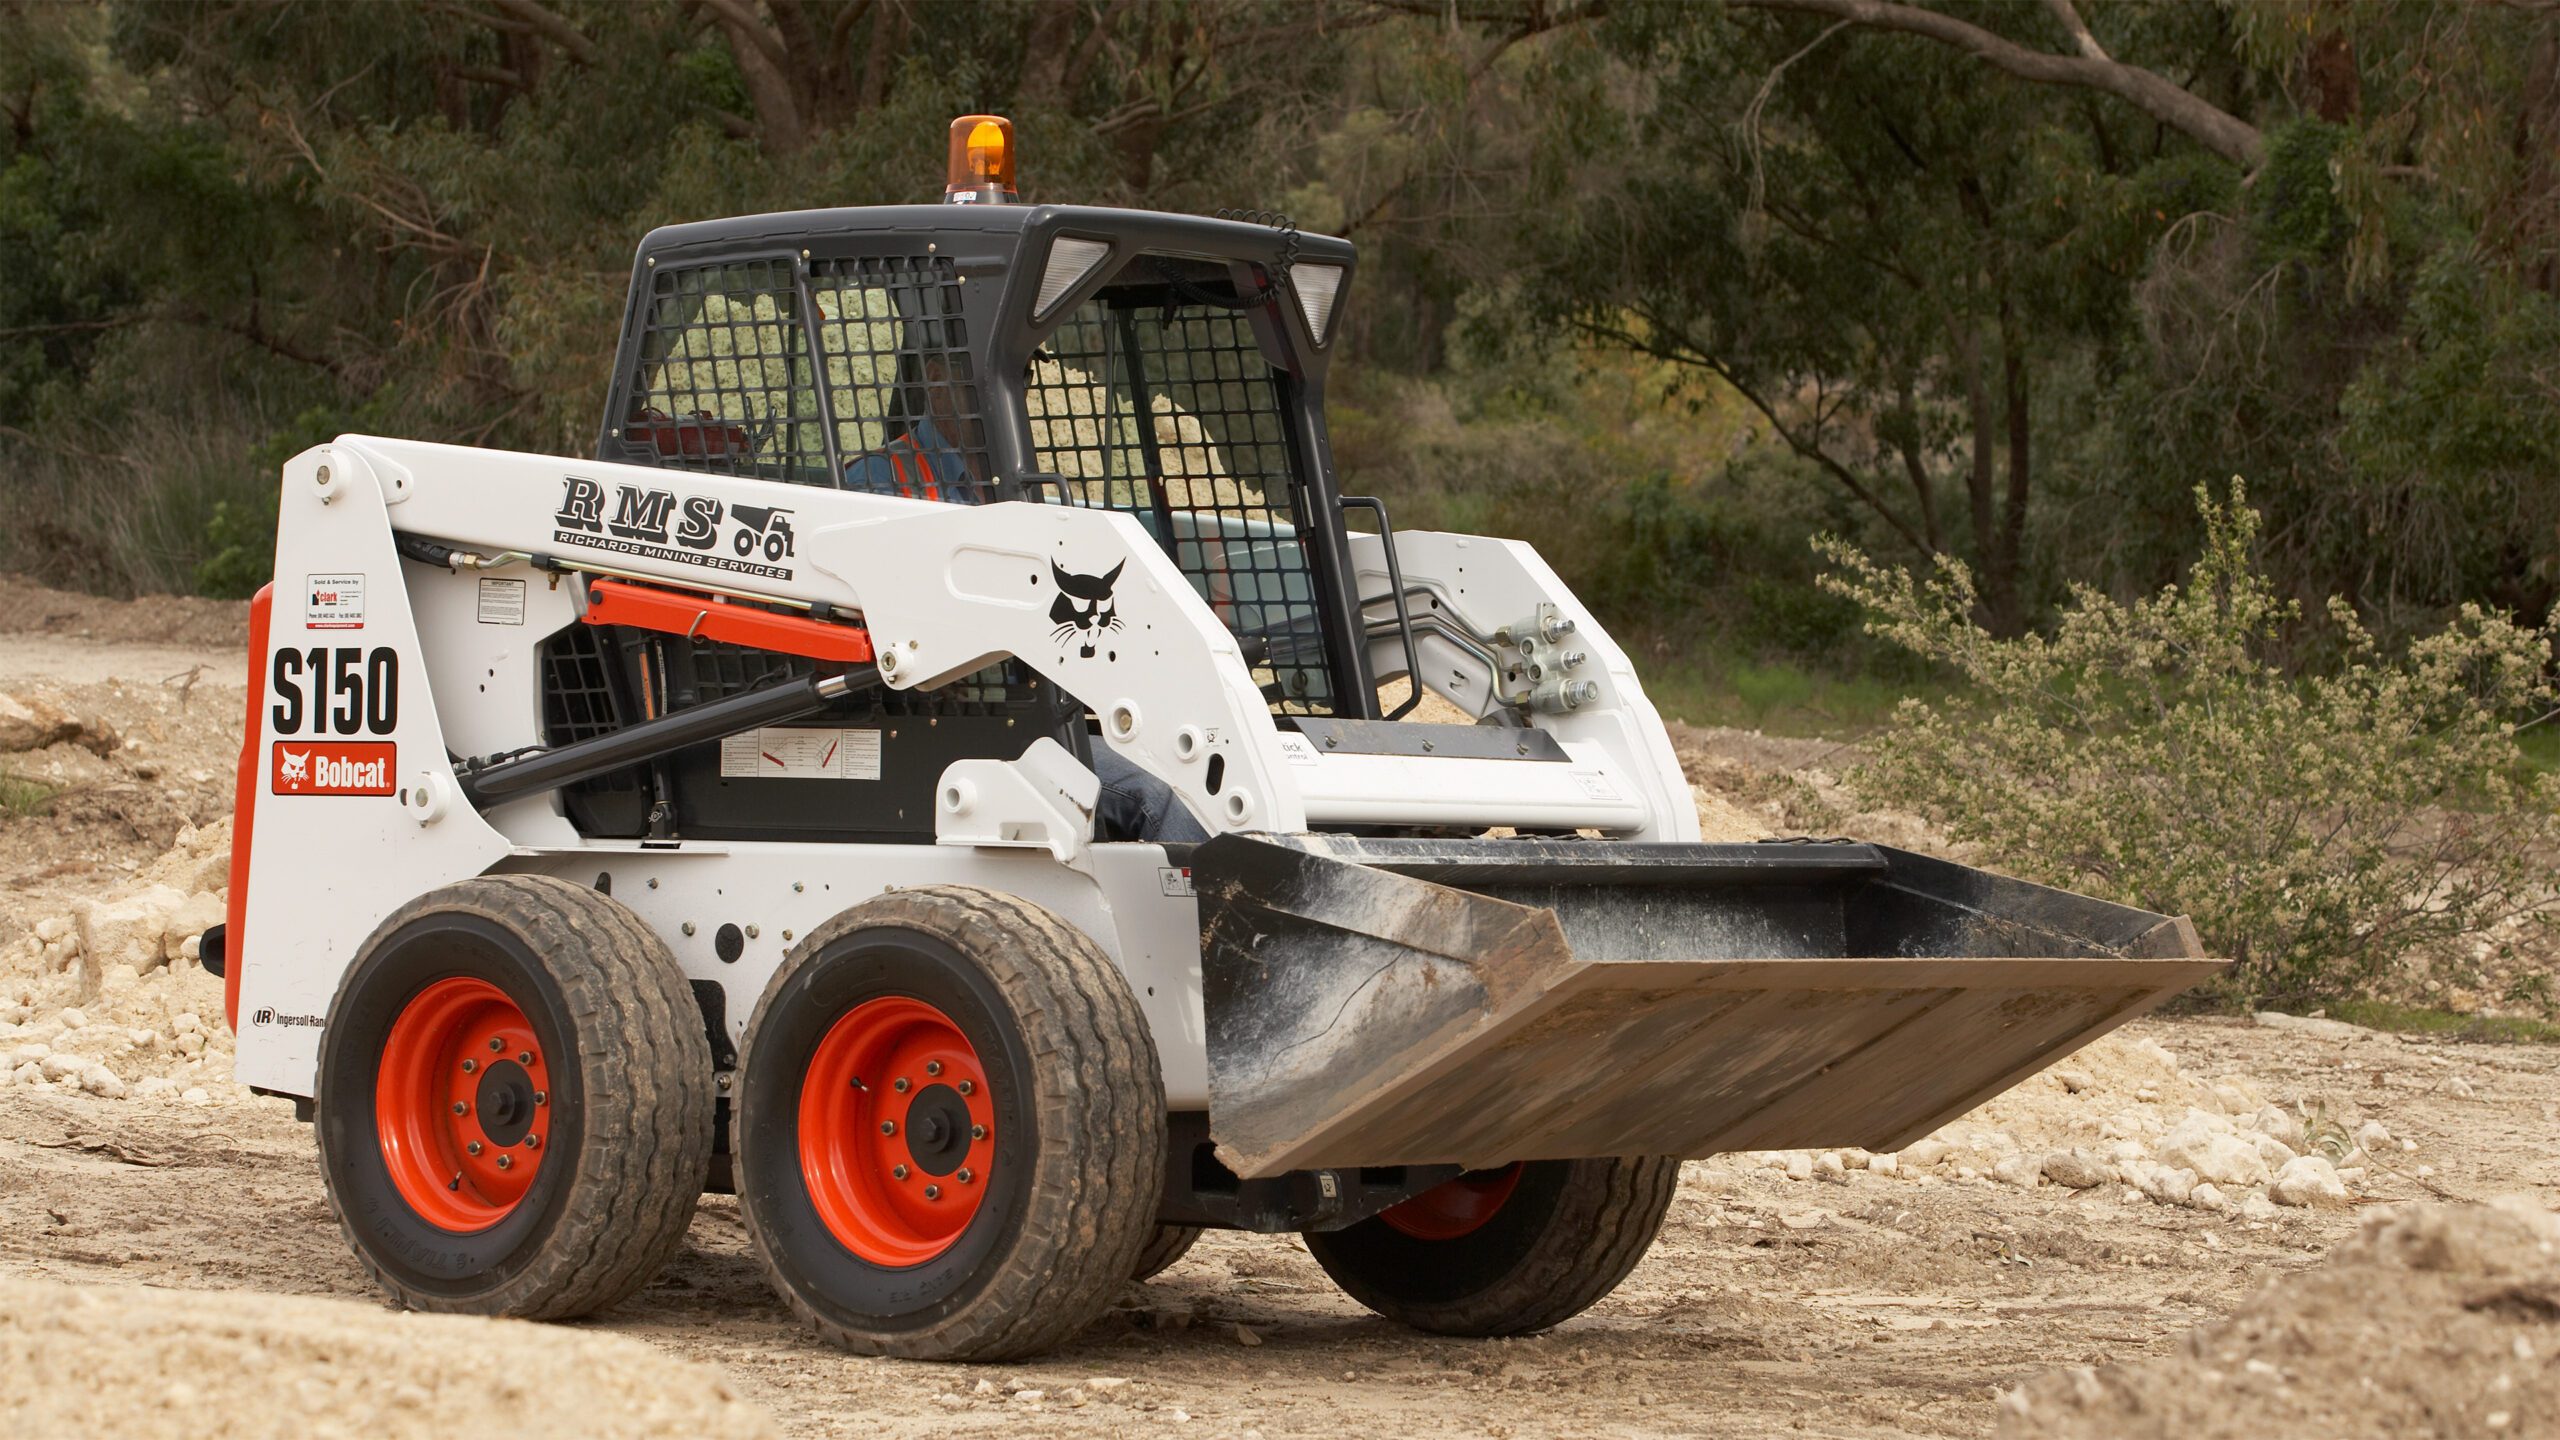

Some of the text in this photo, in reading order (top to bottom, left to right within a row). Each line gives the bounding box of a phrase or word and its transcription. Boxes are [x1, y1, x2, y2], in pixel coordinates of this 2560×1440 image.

[554, 474, 724, 550] RMS
[558, 532, 787, 579] RICHARDS MINING SERVICES
[320, 591, 337, 602] clark
[273, 646, 399, 735] S150
[315, 755, 386, 788] Bobcat
[256, 1009, 271, 1024] IR
